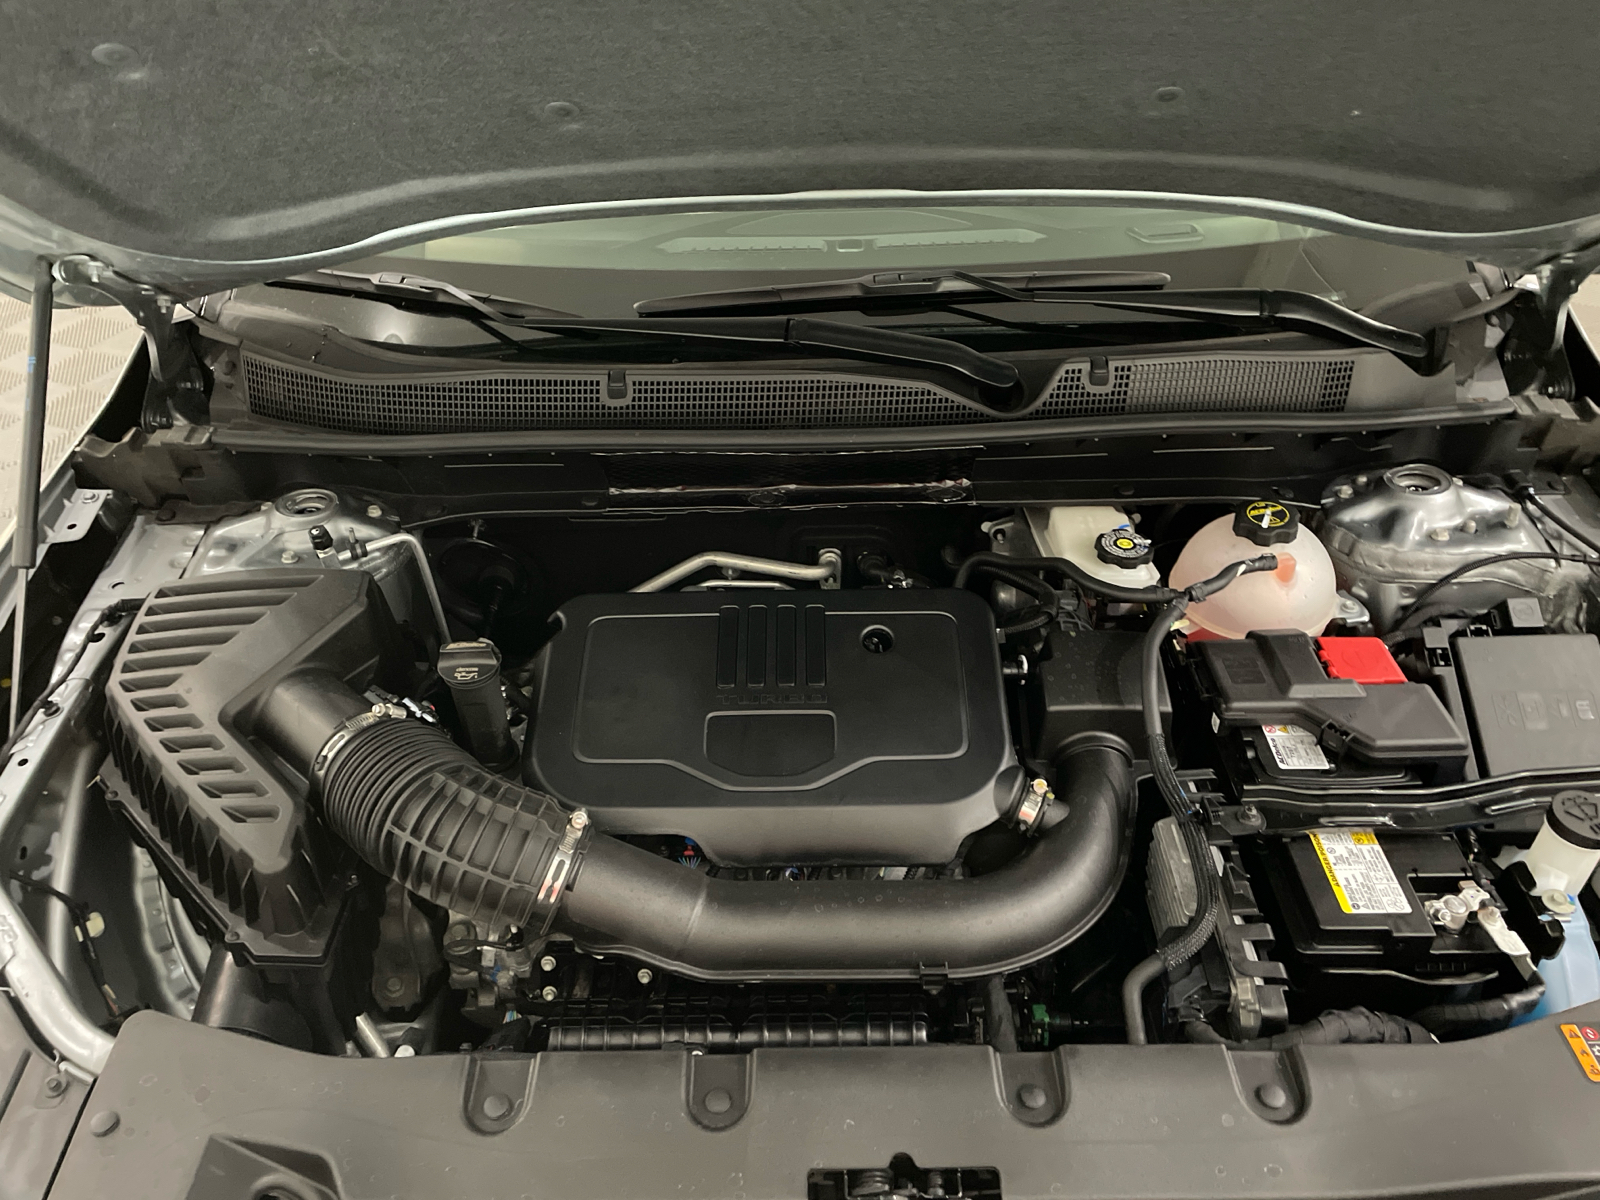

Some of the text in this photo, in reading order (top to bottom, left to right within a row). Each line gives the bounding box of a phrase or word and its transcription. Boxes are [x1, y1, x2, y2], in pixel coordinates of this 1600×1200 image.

[716, 694, 827, 704] TURBO
[1270, 737, 1287, 765] ACDelco
[1309, 831, 1339, 882] DANGER POISON
